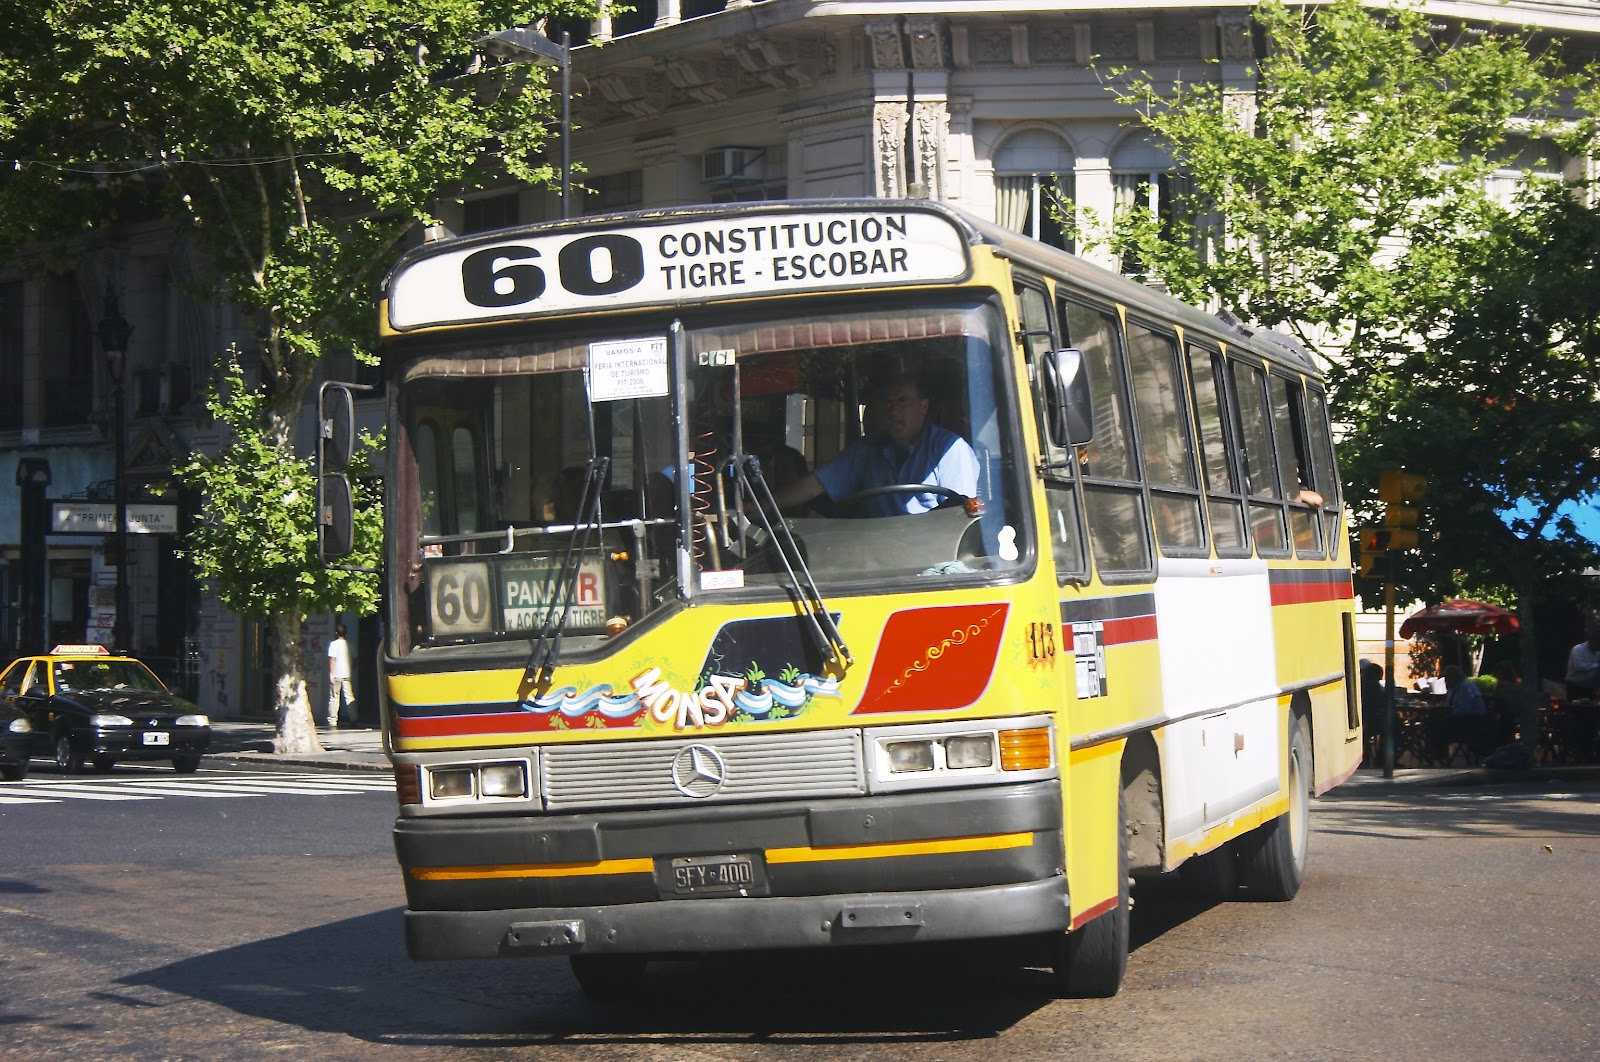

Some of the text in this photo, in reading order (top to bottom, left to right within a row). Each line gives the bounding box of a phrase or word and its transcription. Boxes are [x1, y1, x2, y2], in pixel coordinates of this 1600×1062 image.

[659, 215, 907, 258] CONSTITUCION
[462, 233, 644, 308] 60
[660, 260, 746, 291] TIGRE
[773, 247, 909, 283] ESCOBAR
[594, 358, 667, 370] FERIA INTERNACIONAL
[605, 348, 635, 356] VAMOS
[621, 368, 650, 377] TURISMO
[436, 570, 487, 626] 60
[579, 572, 598, 602] R
[572, 609, 604, 627] TIGRE
[630, 667, 747, 730] MONSA
[675, 863, 750, 887] SFY 400
